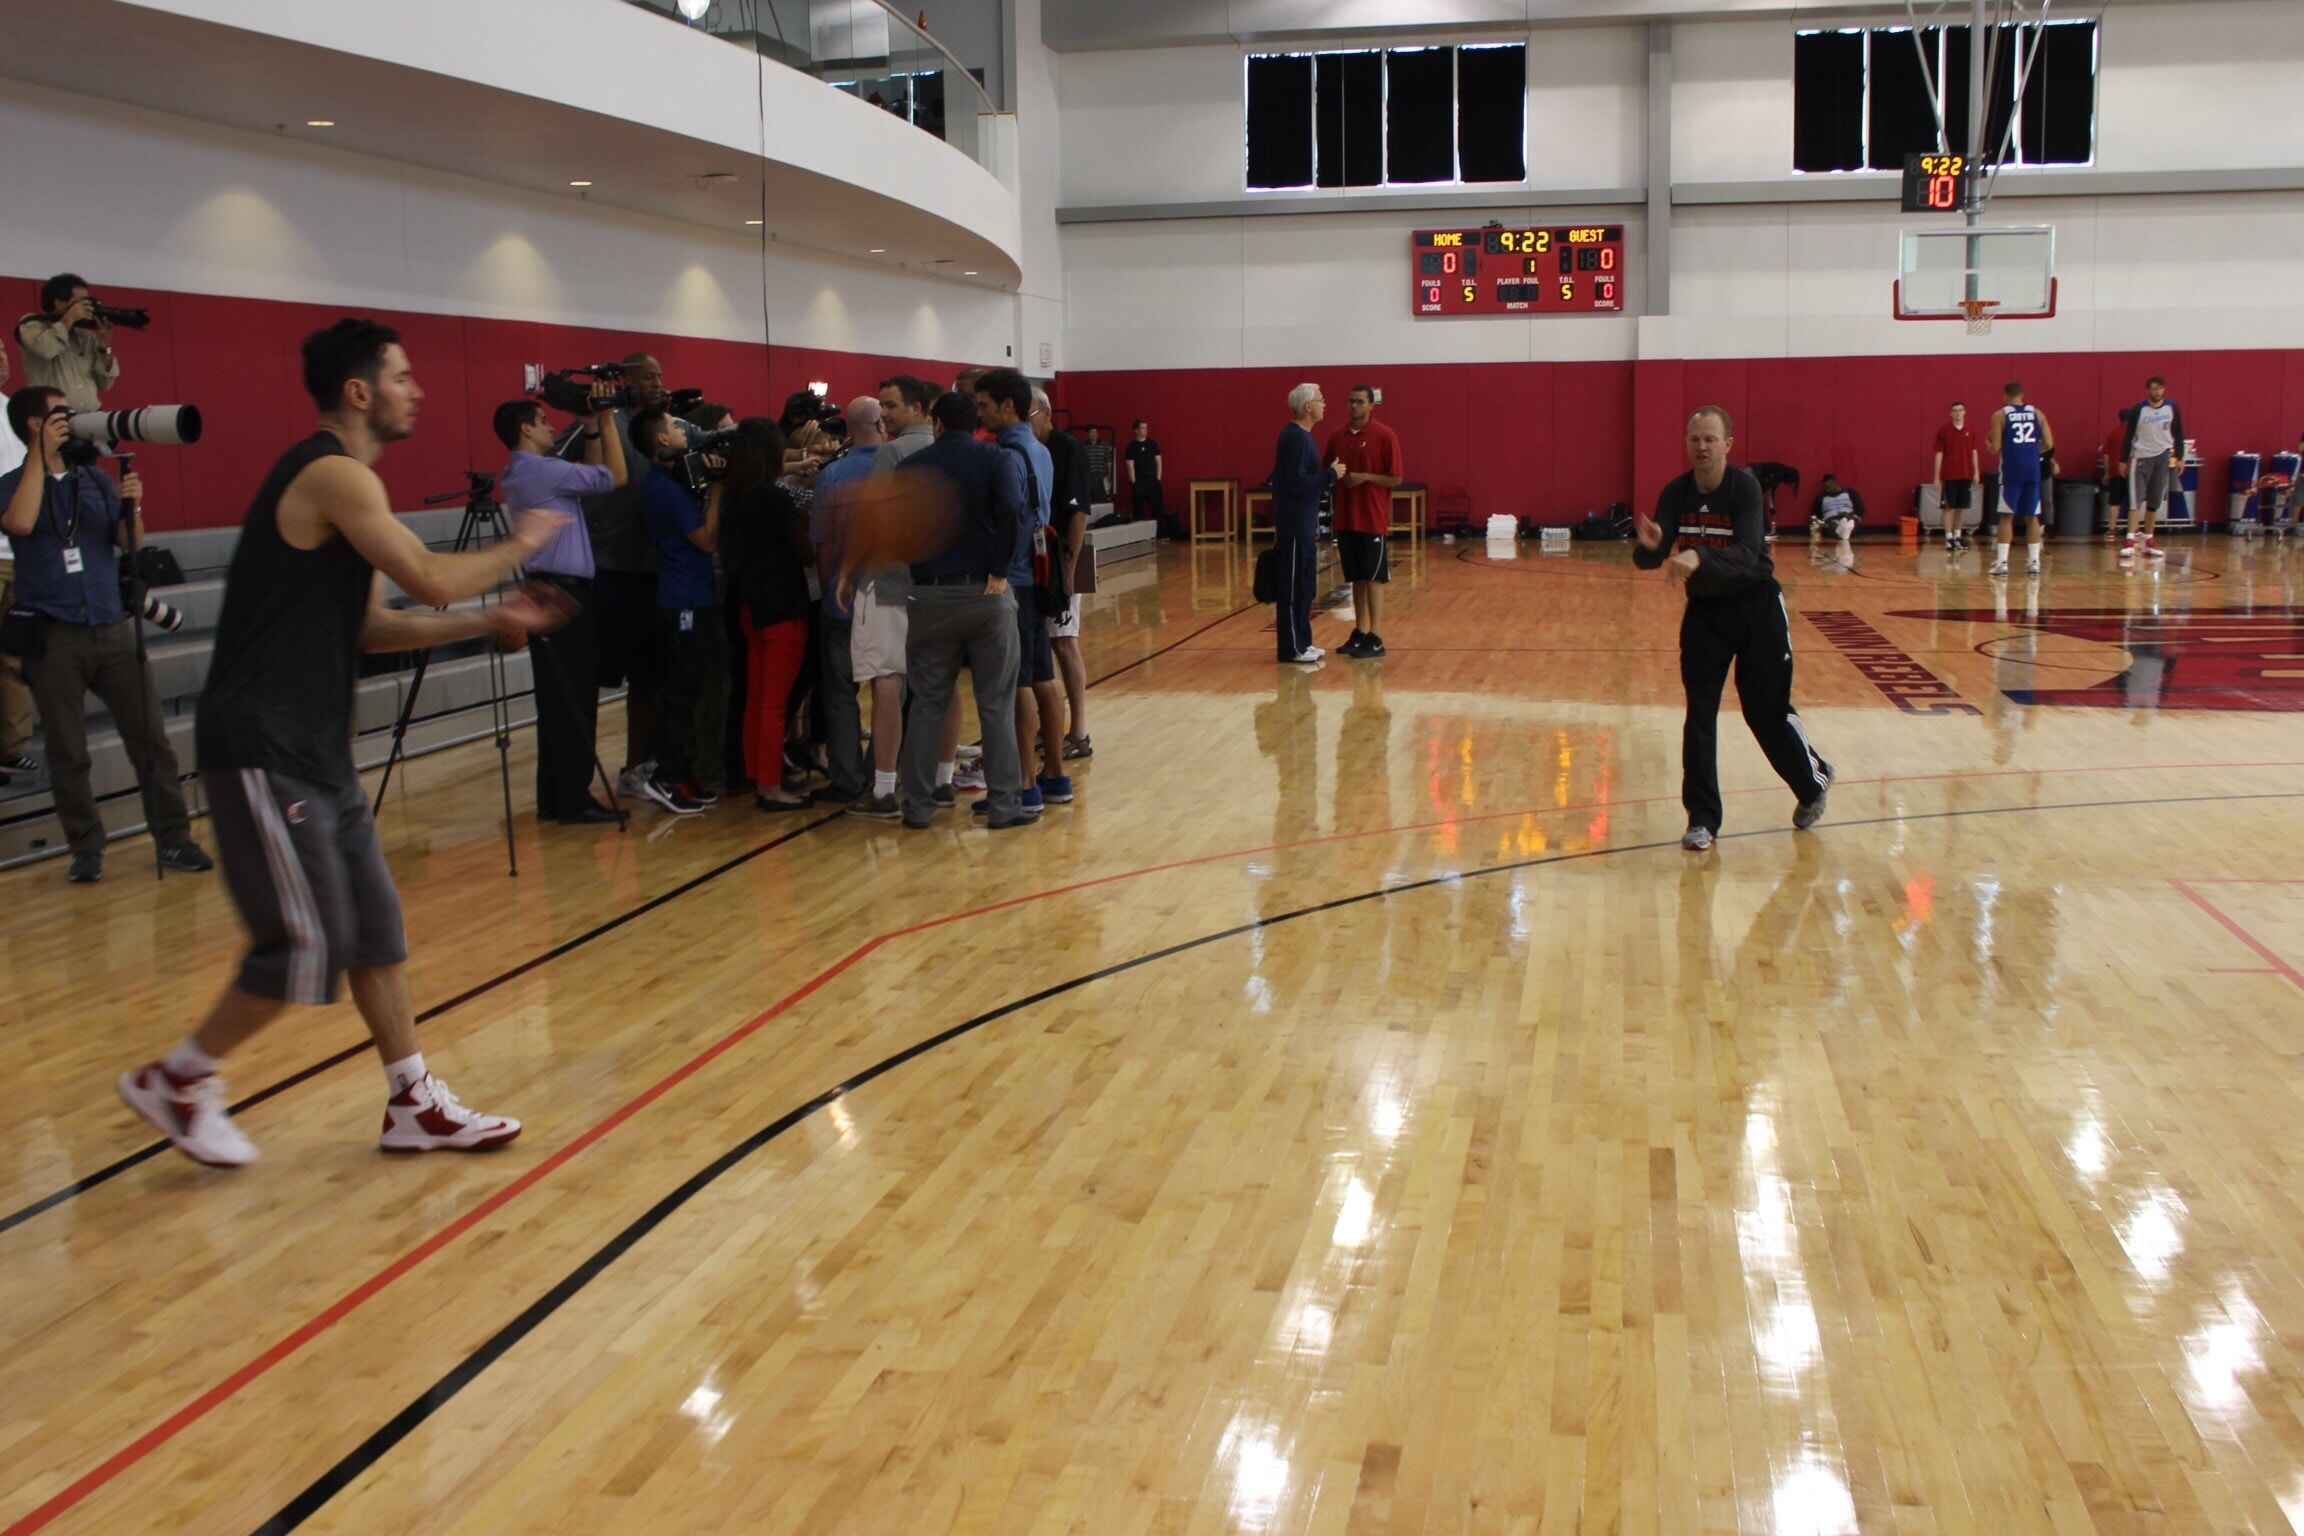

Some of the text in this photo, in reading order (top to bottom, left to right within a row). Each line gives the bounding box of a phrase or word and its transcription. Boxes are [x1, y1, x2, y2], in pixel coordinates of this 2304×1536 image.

[1921, 156, 1962, 176] 9:22
[1928, 175, 1954, 207] 10
[1433, 233, 1462, 246] HOME
[1500, 231, 1549, 252] 9:22
[1569, 229, 1605, 242] GUEST
[1443, 252, 1456, 273] 0
[1530, 259, 1536, 273] 1
[1600, 248, 1613, 269] 0
[1594, 275, 1615, 283] FOULS
[1430, 287, 1439, 302] 0
[1603, 283, 1613, 298] 0
[1506, 302, 1528, 310] MATCH
[2011, 422, 2036, 444] 32
[1843, 653, 1985, 716] REBELS
